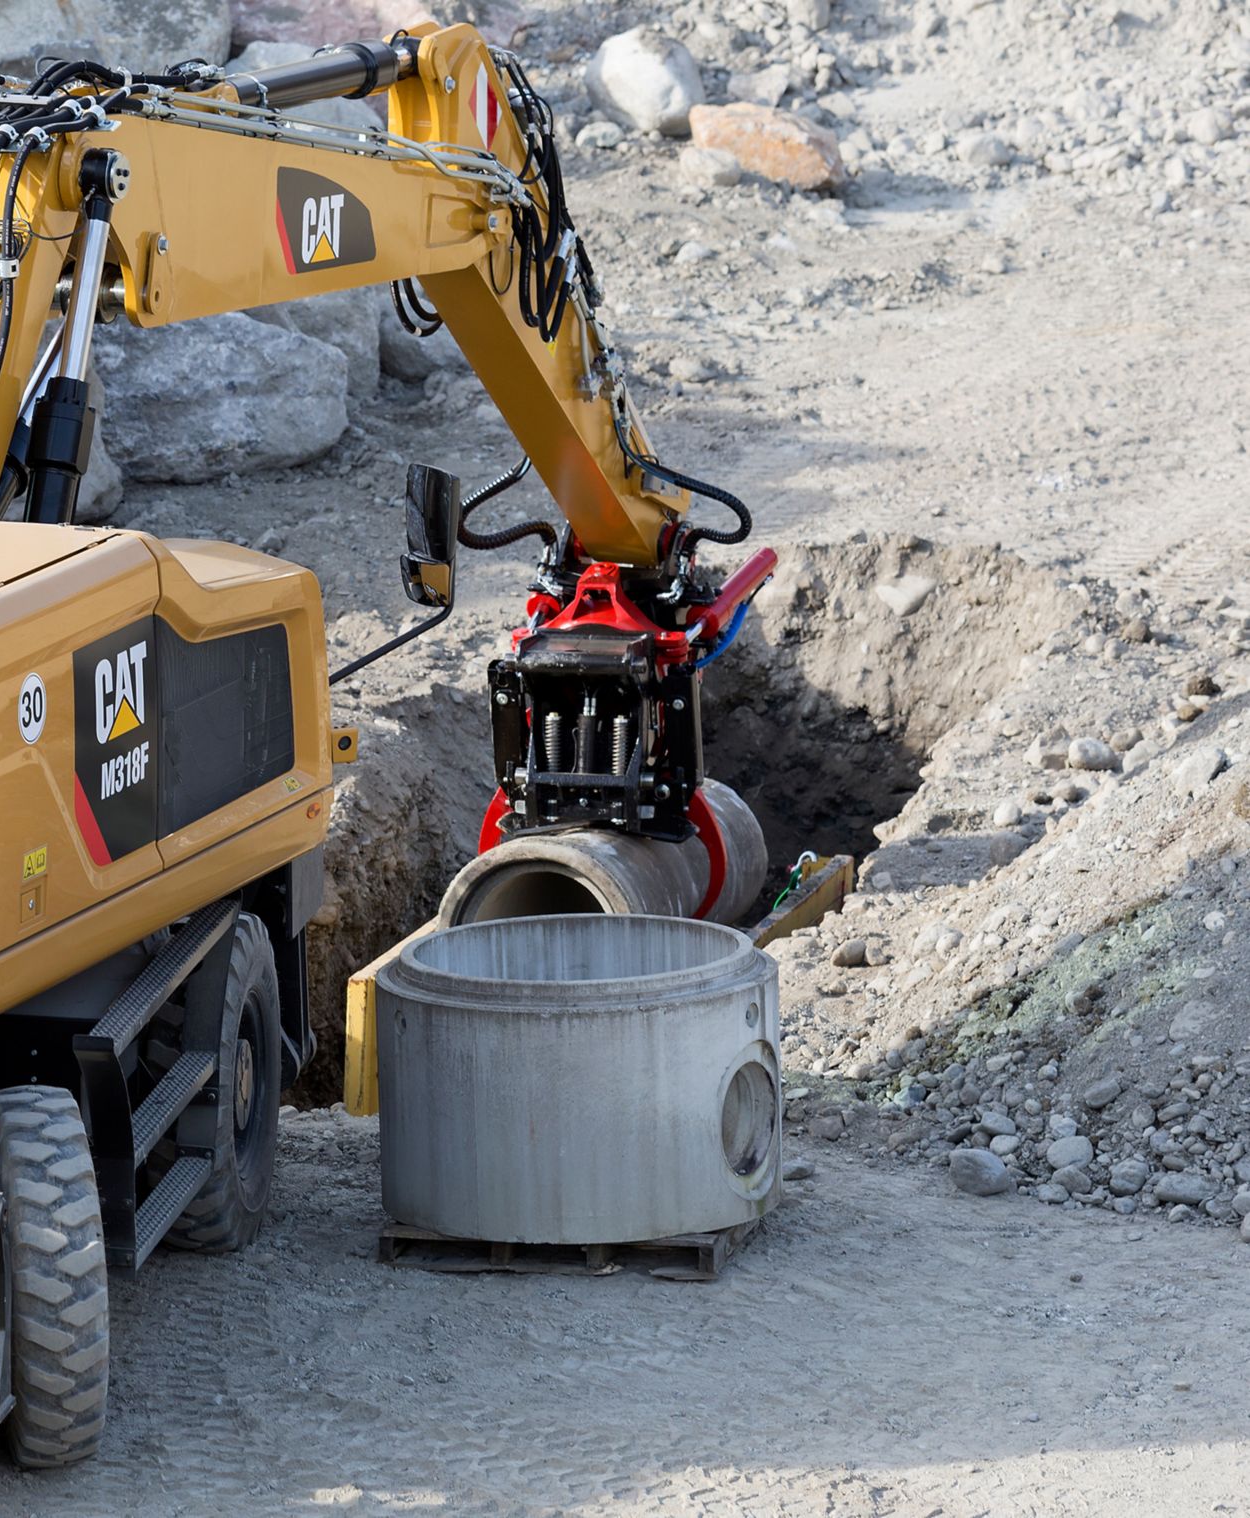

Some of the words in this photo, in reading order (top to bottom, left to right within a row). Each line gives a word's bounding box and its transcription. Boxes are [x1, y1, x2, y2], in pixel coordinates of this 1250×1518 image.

[301, 193, 344, 264] CAT
[22, 687, 43, 728] 30
[94, 640, 147, 744] CAT
[101, 741, 149, 800] M318F
